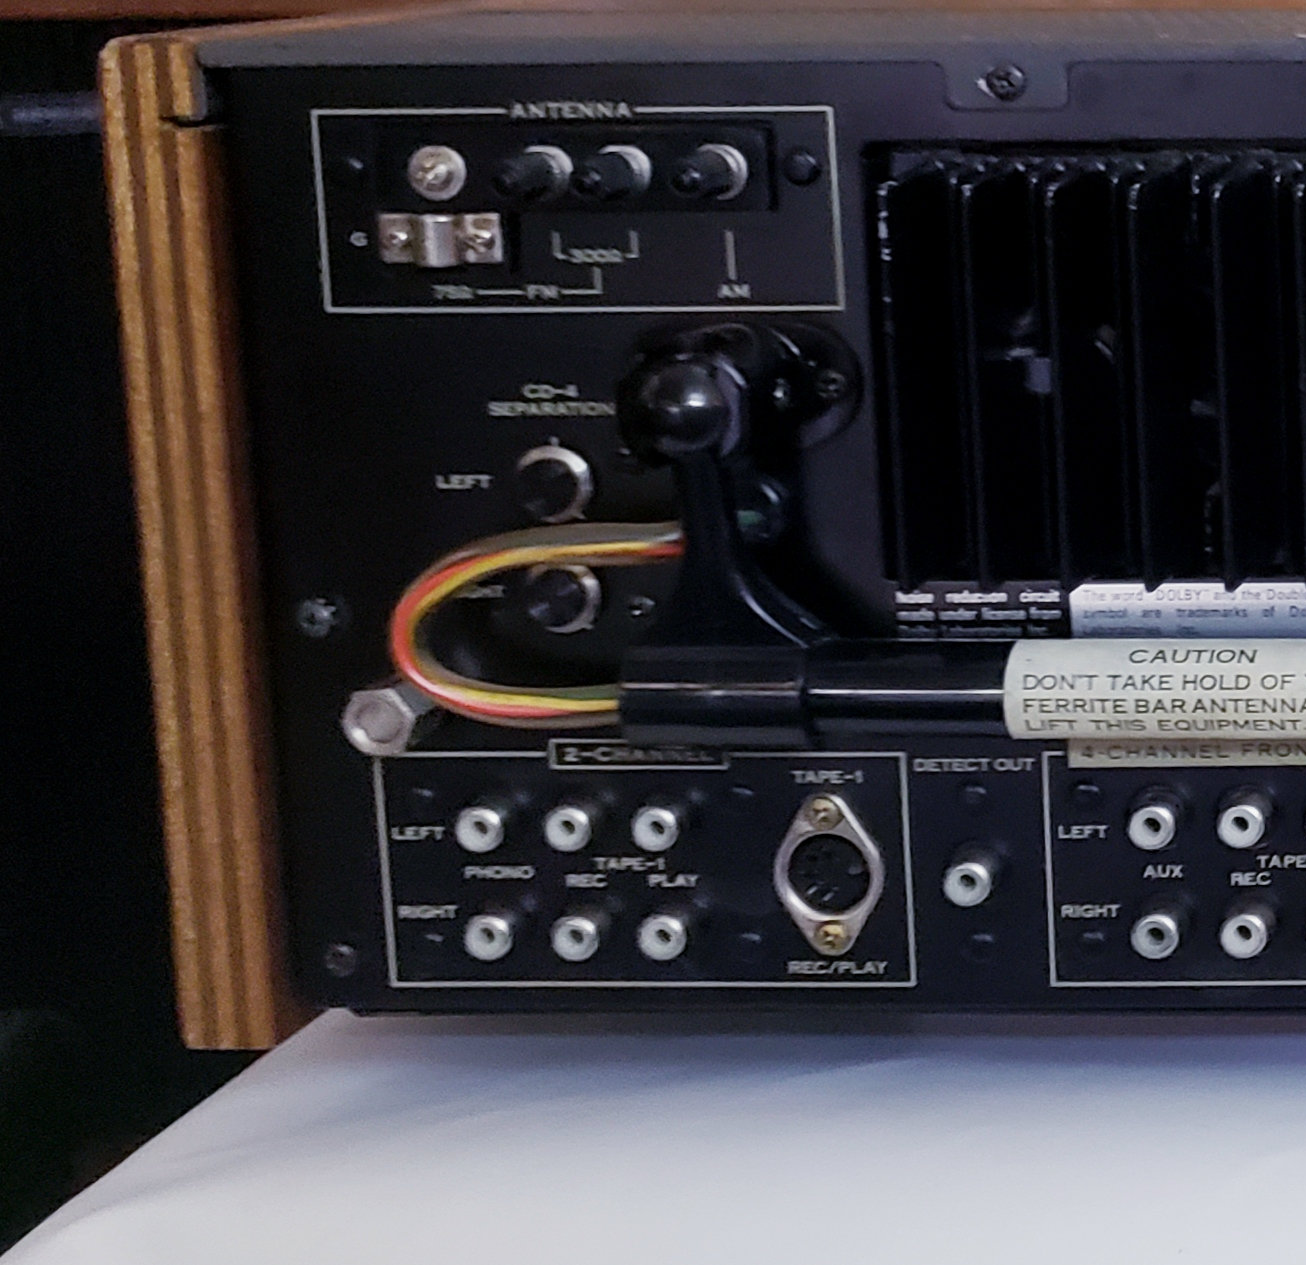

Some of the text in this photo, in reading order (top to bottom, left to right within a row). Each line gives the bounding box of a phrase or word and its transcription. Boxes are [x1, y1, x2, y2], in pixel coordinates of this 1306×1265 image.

[509, 101, 633, 120] ANTENNA
[718, 284, 749, 299] AM
[487, 401, 617, 417] SEPARATION
[435, 475, 493, 489] LEFT
[1128, 649, 1258, 664] CAUTION
[1022, 674, 1099, 691] DON'T
[1107, 674, 1174, 691] TAKE
[1182, 674, 1250, 691] HOLD
[1260, 673, 1295, 691] OF
[1022, 698, 1126, 715] FERRITE
[1134, 698, 1188, 715] BAR
[1024, 718, 1077, 733] LIFT
[1088, 718, 1147, 733] THIS
[1081, 744, 1230, 760] 4-CHANNEL
[391, 826, 445, 841] LEFT
[1058, 824, 1108, 839] LEFT
[464, 866, 700, 889] PHONO REC PLAY
[1143, 864, 1184, 879] AUX
[1230, 871, 1272, 886] REC
[398, 905, 458, 919] RIGHT
[1061, 904, 1120, 919] RIGHT
[788, 960, 888, 975] REC/PLAY
